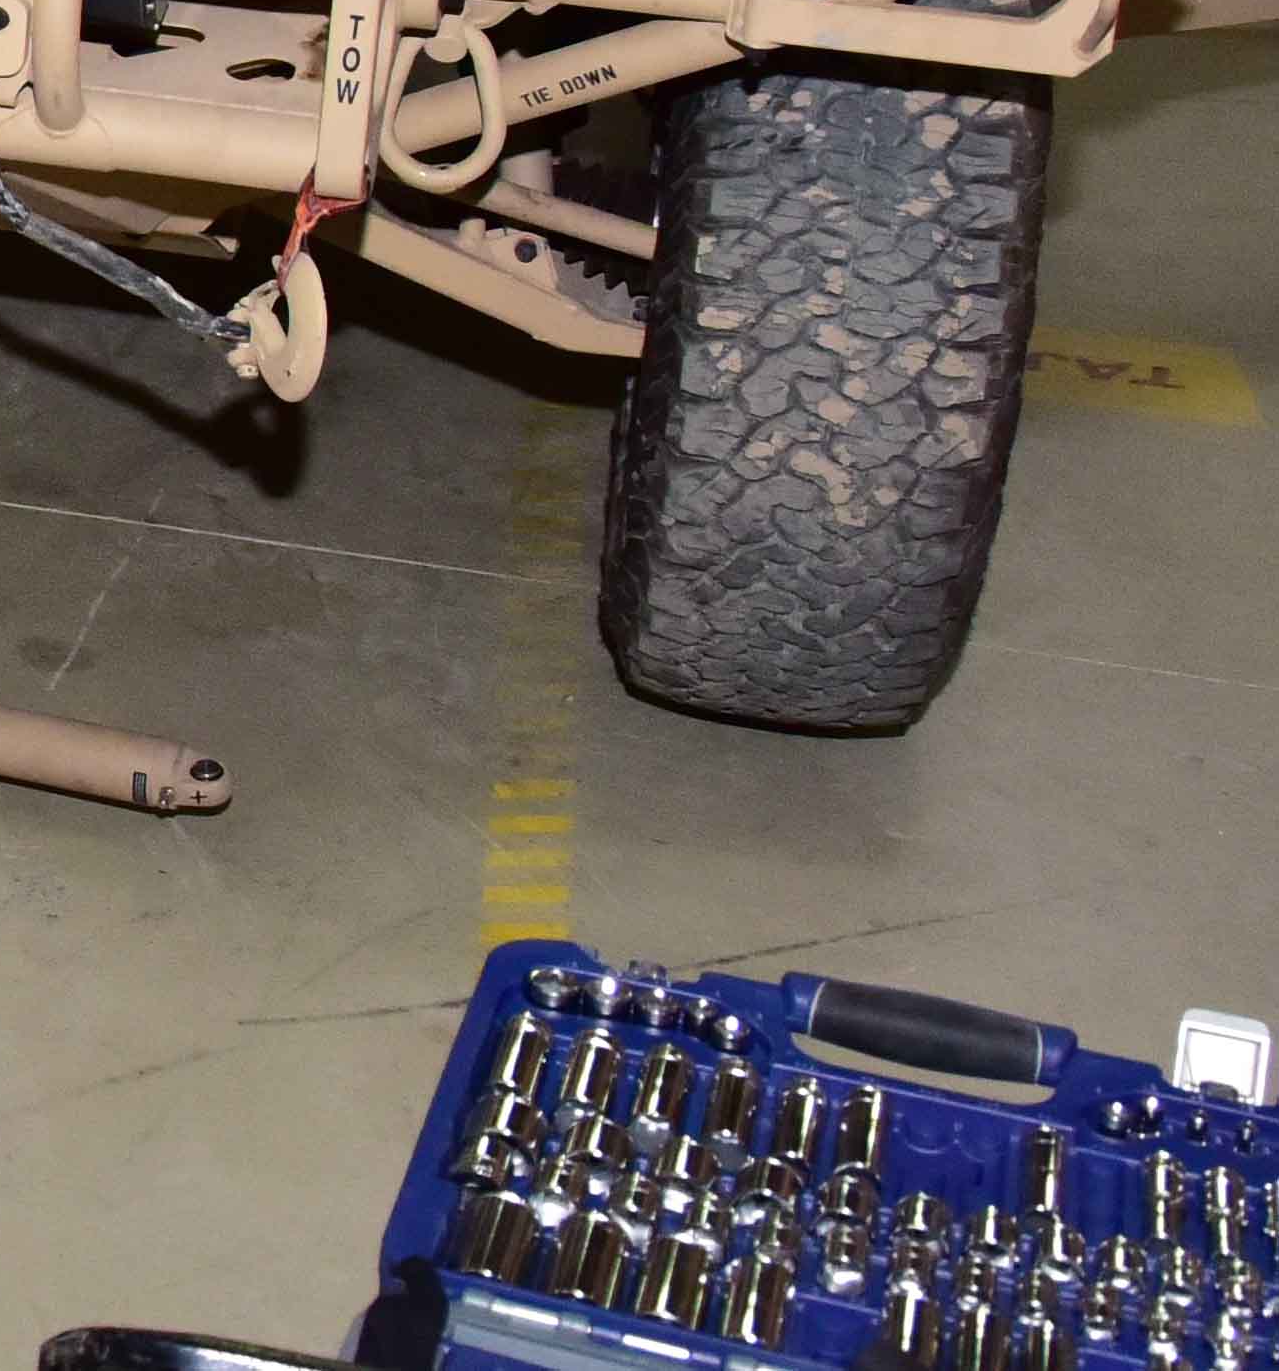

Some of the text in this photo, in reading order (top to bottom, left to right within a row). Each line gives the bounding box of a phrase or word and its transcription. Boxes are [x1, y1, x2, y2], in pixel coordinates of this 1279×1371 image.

[337, 14, 365, 104] TOW
[520, 64, 617, 107] TIE DOWN
